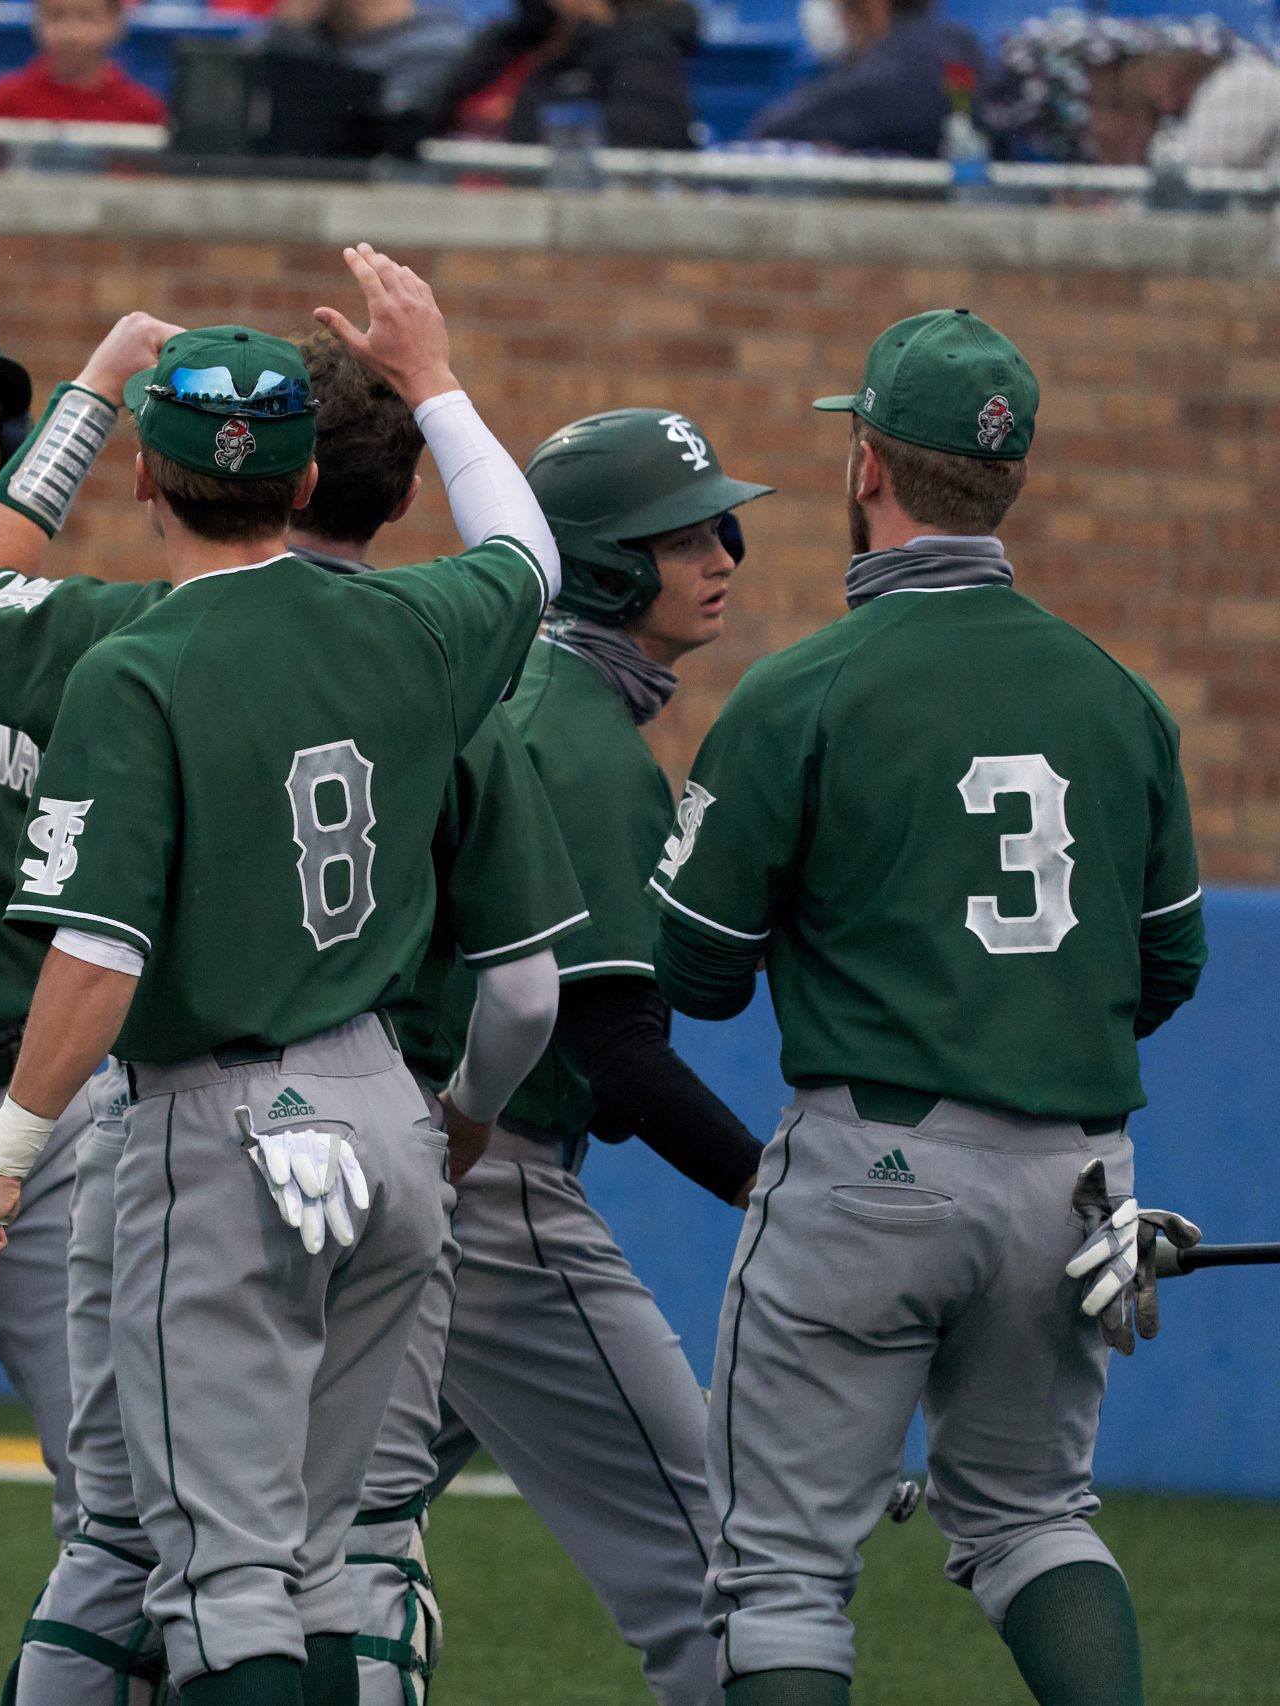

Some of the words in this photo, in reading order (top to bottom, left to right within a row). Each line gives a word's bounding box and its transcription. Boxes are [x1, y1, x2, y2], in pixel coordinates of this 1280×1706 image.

[284, 739, 377, 951] 8
[956, 753, 1079, 954] 3
[268, 1104, 316, 1119] adidas
[867, 1167, 916, 1184] adidas
